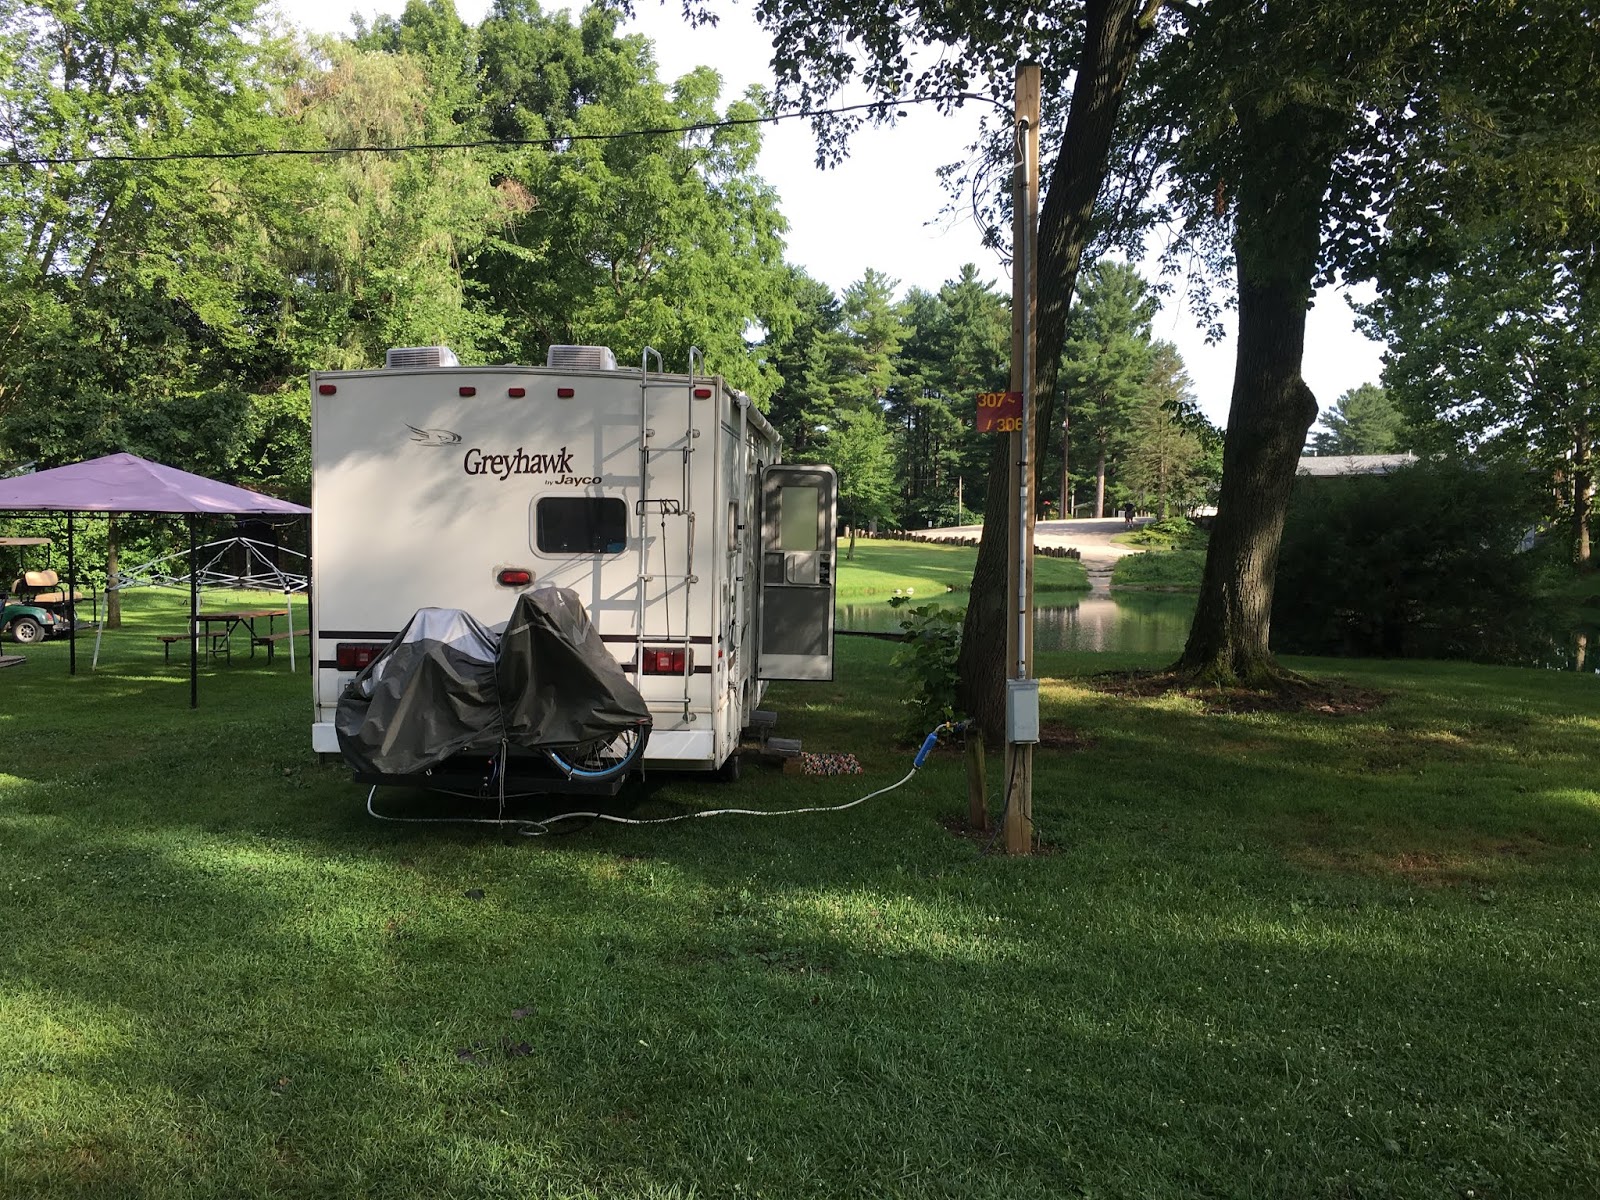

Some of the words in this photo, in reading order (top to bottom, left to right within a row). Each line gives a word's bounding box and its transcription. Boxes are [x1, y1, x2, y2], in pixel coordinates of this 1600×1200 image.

[978, 393, 1006, 407] 307
[996, 417, 1023, 432] 306
[463, 446, 574, 481] Greyhawk
[555, 474, 602, 487] Jayco
